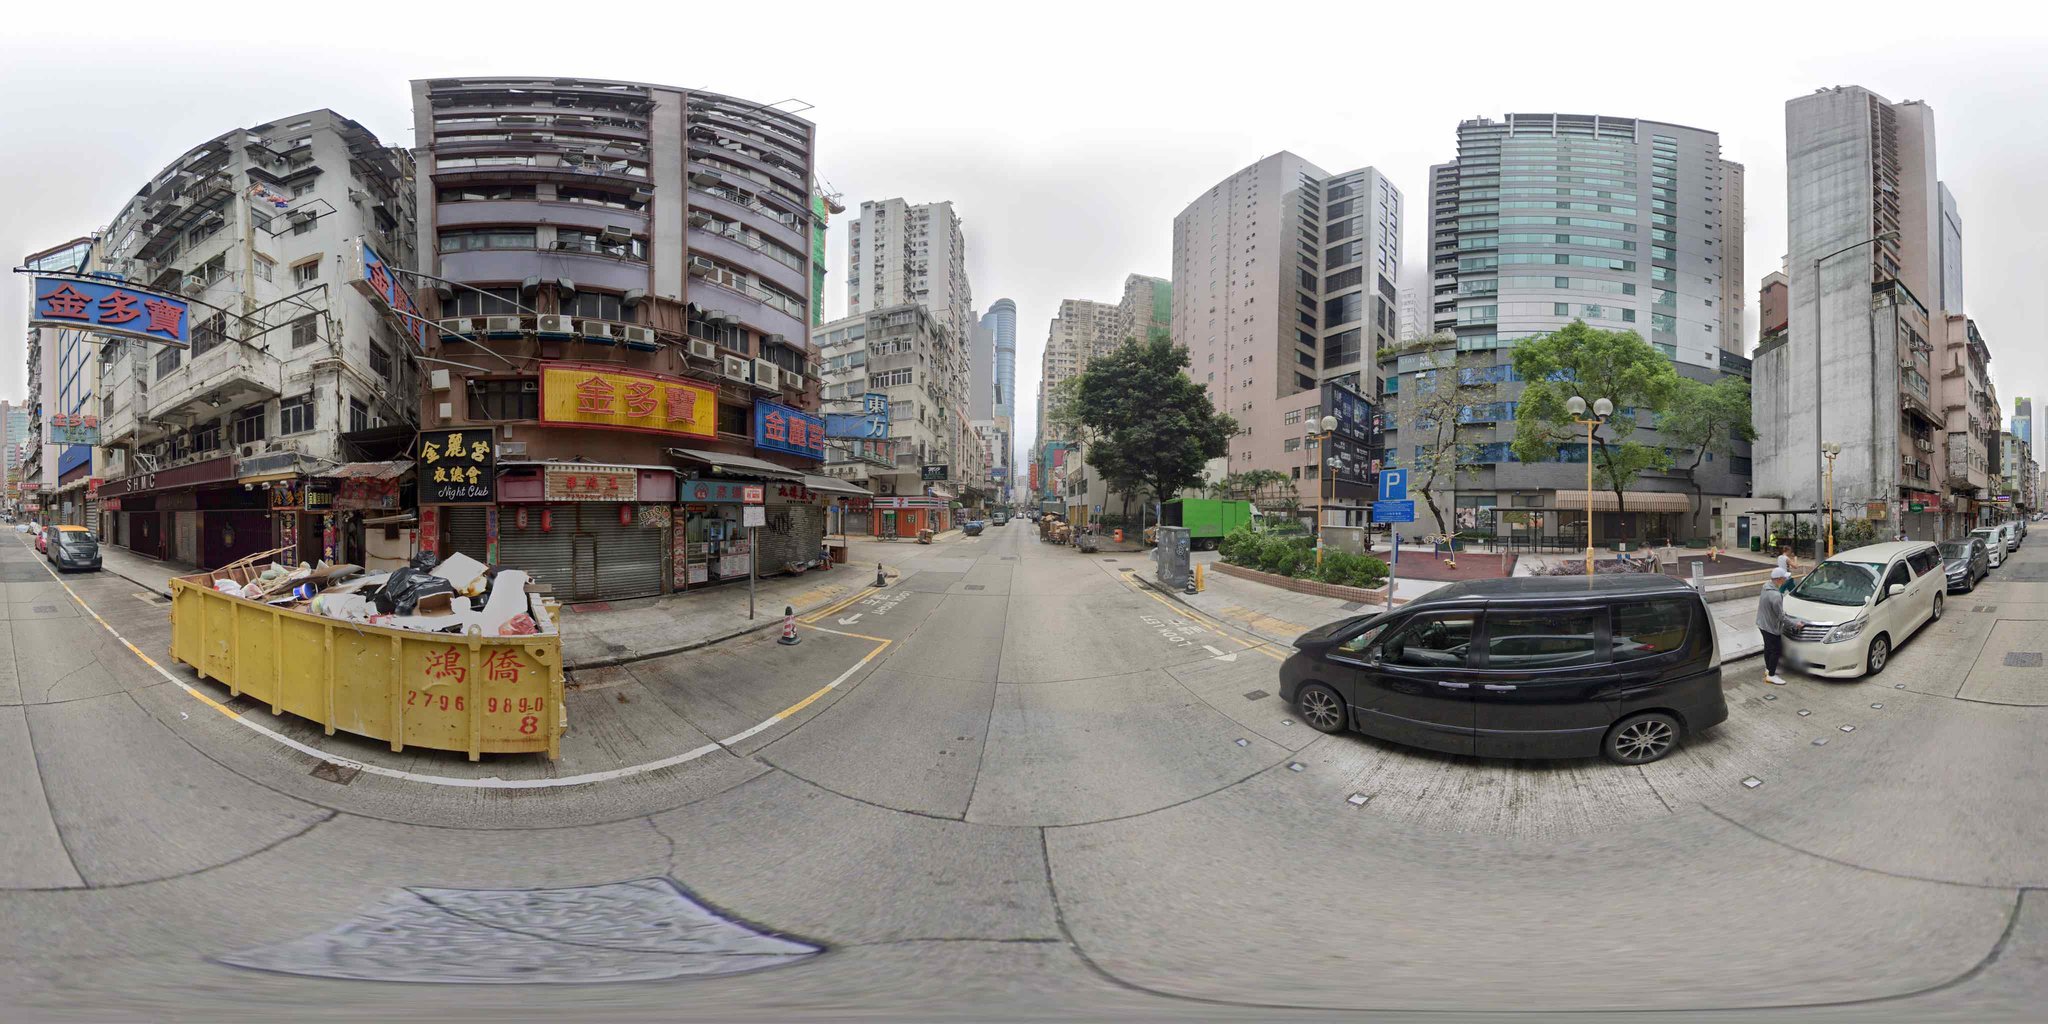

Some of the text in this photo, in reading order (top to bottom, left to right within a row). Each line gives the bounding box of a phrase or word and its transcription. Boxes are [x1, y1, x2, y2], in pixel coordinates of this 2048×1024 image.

[38, 282, 184, 338] 金多寶
[576, 376, 697, 425] 金多寶
[765, 411, 824, 451] 金麗宮
[866, 396, 885, 437] 東方
[126, 473, 155, 492] SHMC
[433, 466, 481, 484] 夜總會
[1386, 472, 1400, 498] P
[438, 485, 489, 500] Night Club
[1140, 615, 1192, 647] LOOK LEFT
[425, 645, 525, 684] 鴻僑
[407, 690, 465, 711] 2796
[519, 715, 538, 734] 8
